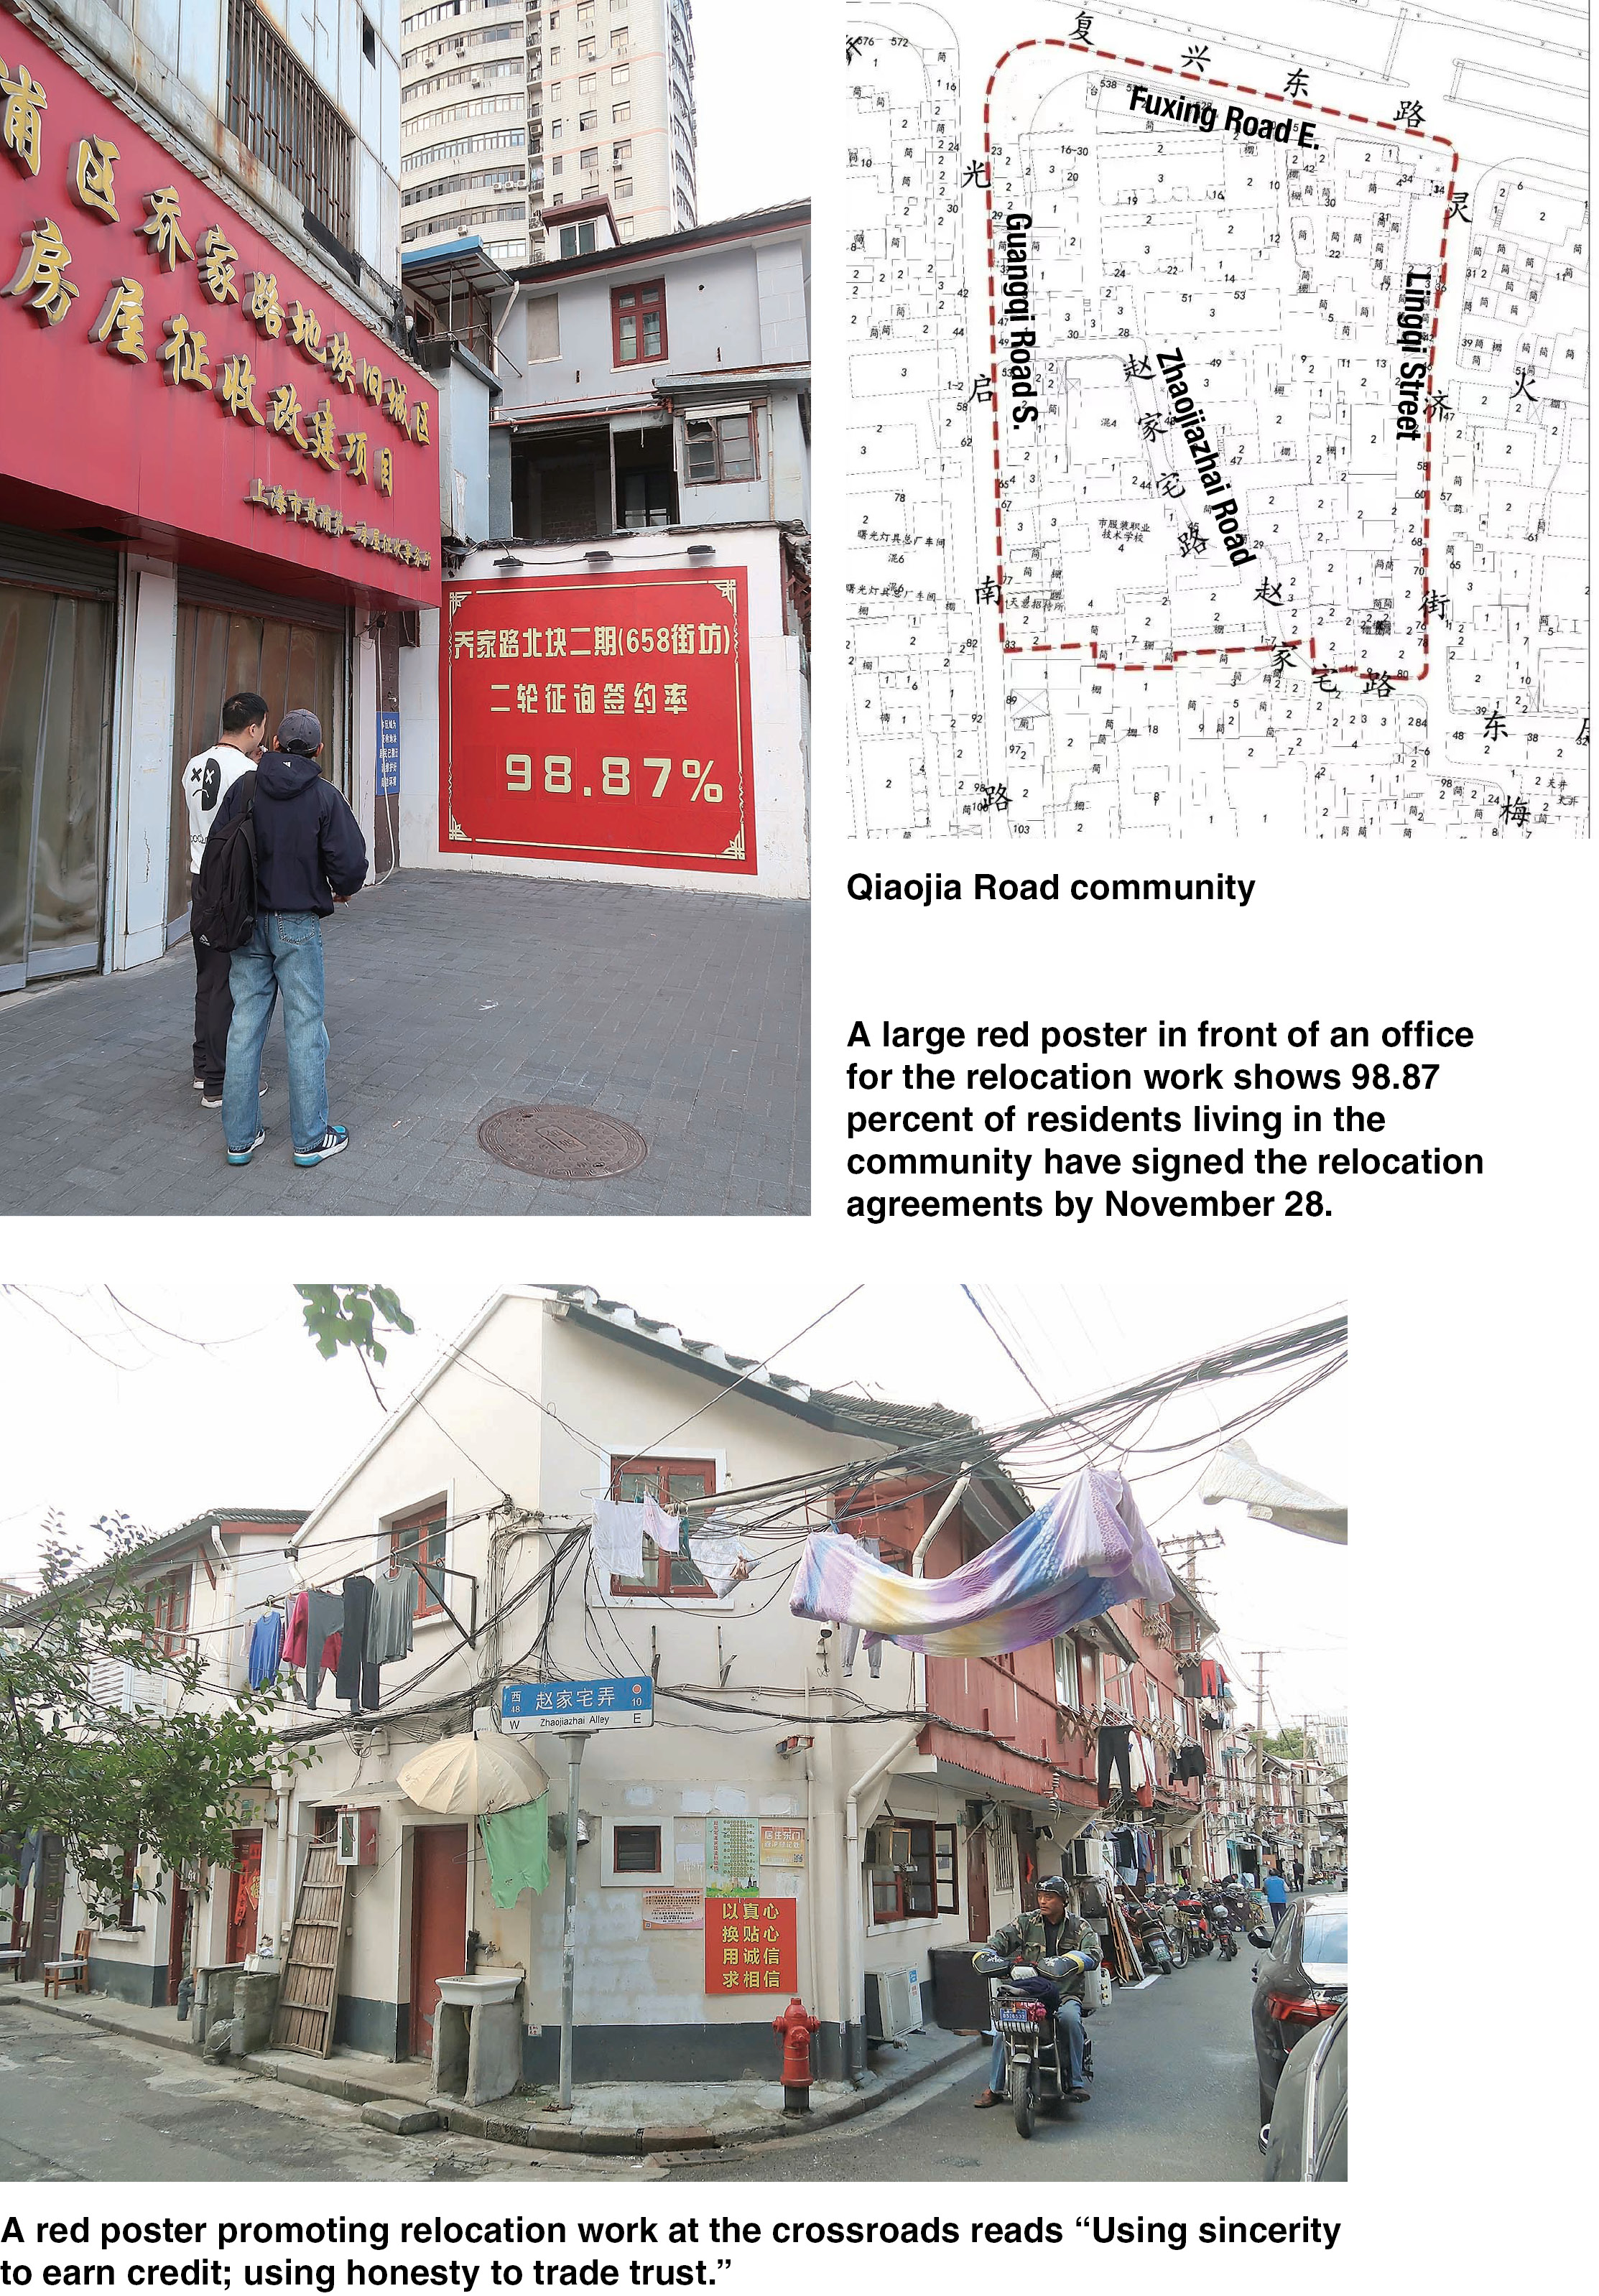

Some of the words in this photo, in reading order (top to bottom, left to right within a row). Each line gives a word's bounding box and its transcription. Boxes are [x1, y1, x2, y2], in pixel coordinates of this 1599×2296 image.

[1181, 45, 1211, 73] 兴
[1283, 68, 1310, 98] 东
[1394, 100, 1426, 128] 路
[962, 159, 991, 188] 光
[1509, 373, 1539, 402] 火
[1138, 412, 1168, 442] 家
[975, 575, 1002, 605] 南
[1418, 590, 1450, 621] 街
[453, 623, 731, 659] 乔家路北块二期(658街坊)
[491, 682, 689, 715] 二轮征询签约率
[1483, 710, 1508, 742] 东
[505, 753, 723, 804] 98.87%
[510, 1691, 522, 1703] 西
[535, 1686, 616, 1711] 赵家宅弄
[631, 1698, 642, 1706] 10
[509, 1720, 520, 1730] W
[540, 1716, 585, 1727] Zhaojiazhai
[589, 1715, 610, 1726] Alley
[633, 1714, 641, 1724] E
[722, 1903, 780, 1920] 以真心
[722, 1925, 780, 1943] 换贴心
[722, 1948, 781, 1966] 用诚信
[722, 1971, 781, 1989] 求相信
